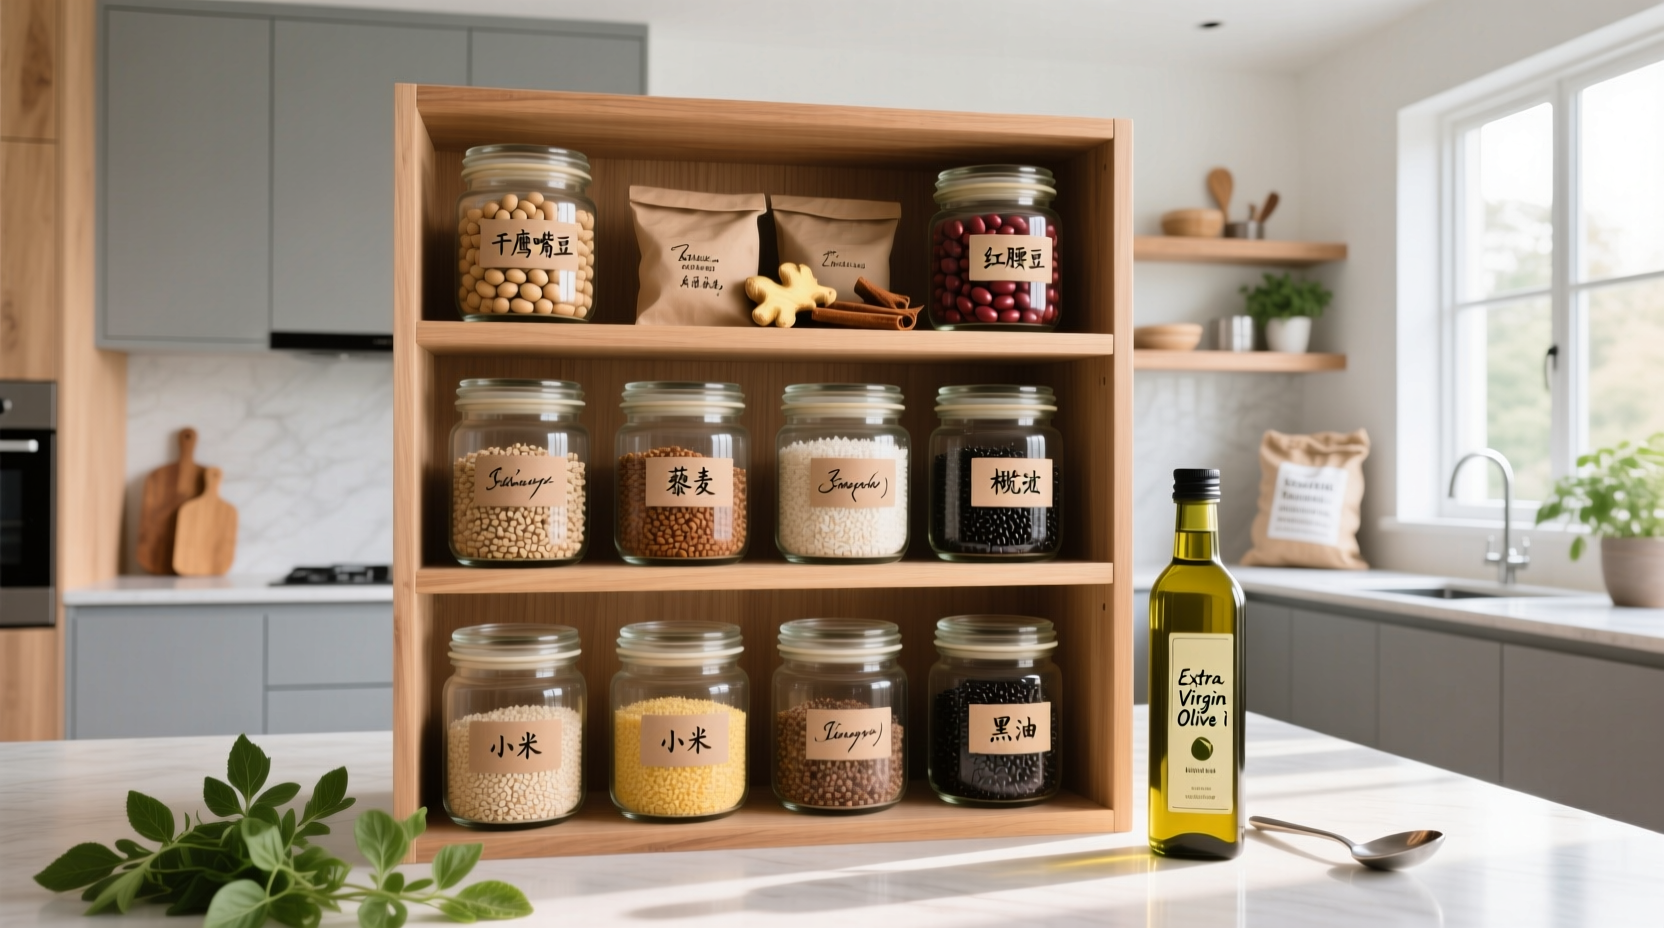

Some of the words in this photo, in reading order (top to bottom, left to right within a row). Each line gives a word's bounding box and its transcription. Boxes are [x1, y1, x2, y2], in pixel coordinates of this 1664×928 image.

[983, 246, 1046, 271] 红腰豆
[665, 466, 716, 497] 藜麦
[1178, 668, 1225, 688] Extra
[1179, 689, 1227, 714] Virgin
[989, 715, 1037, 743] 黑油
[1177, 708, 1217, 727] Olive
[490, 731, 543, 760] 小米
[661, 726, 712, 755] 小米
